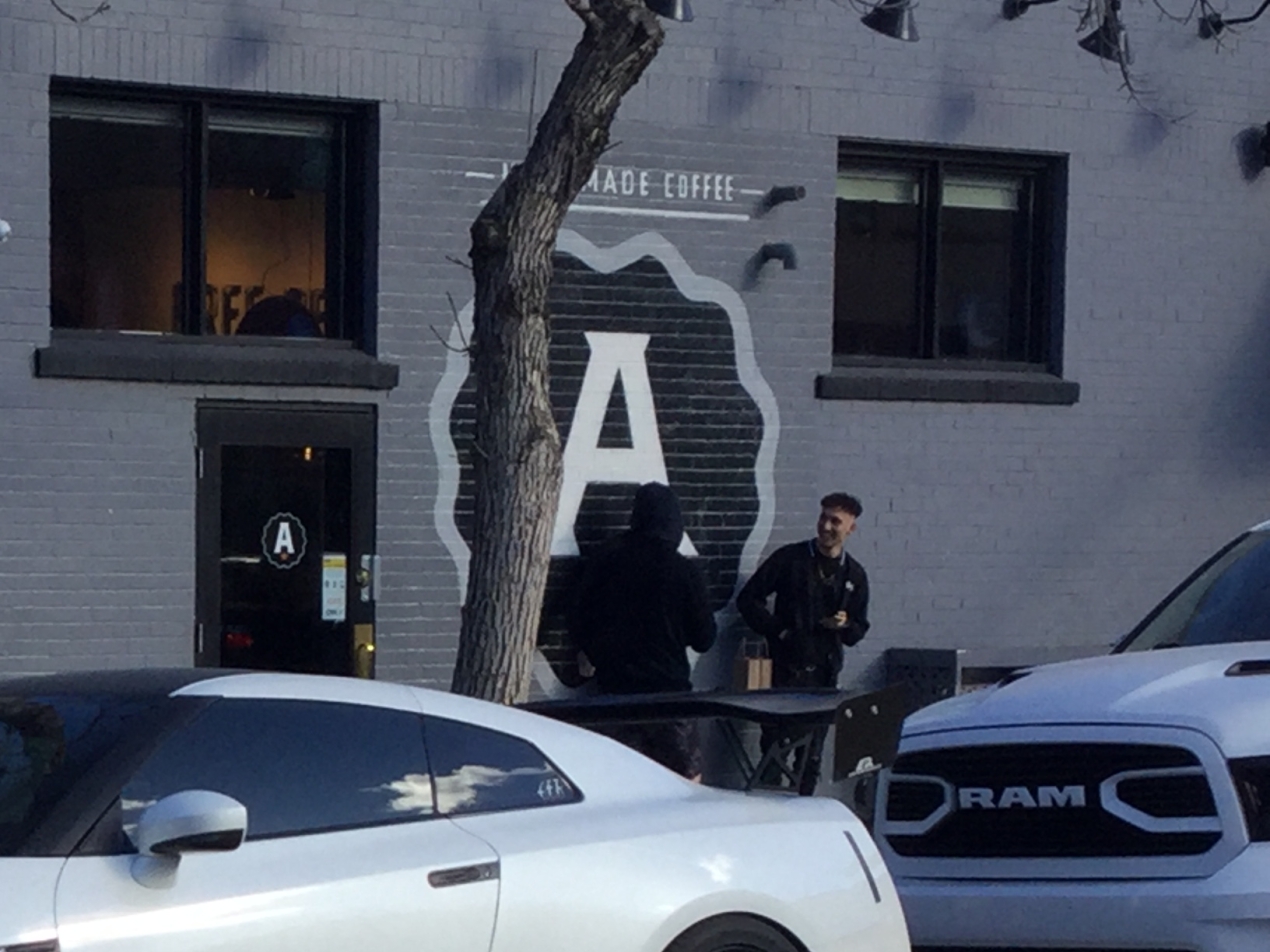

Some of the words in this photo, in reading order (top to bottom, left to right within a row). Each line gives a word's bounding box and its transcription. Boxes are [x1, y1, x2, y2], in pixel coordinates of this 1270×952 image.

[664, 172, 734, 201] COFFEE
[550, 331, 700, 557] A
[273, 522, 295, 553] A
[958, 786, 1086, 808] RAM
